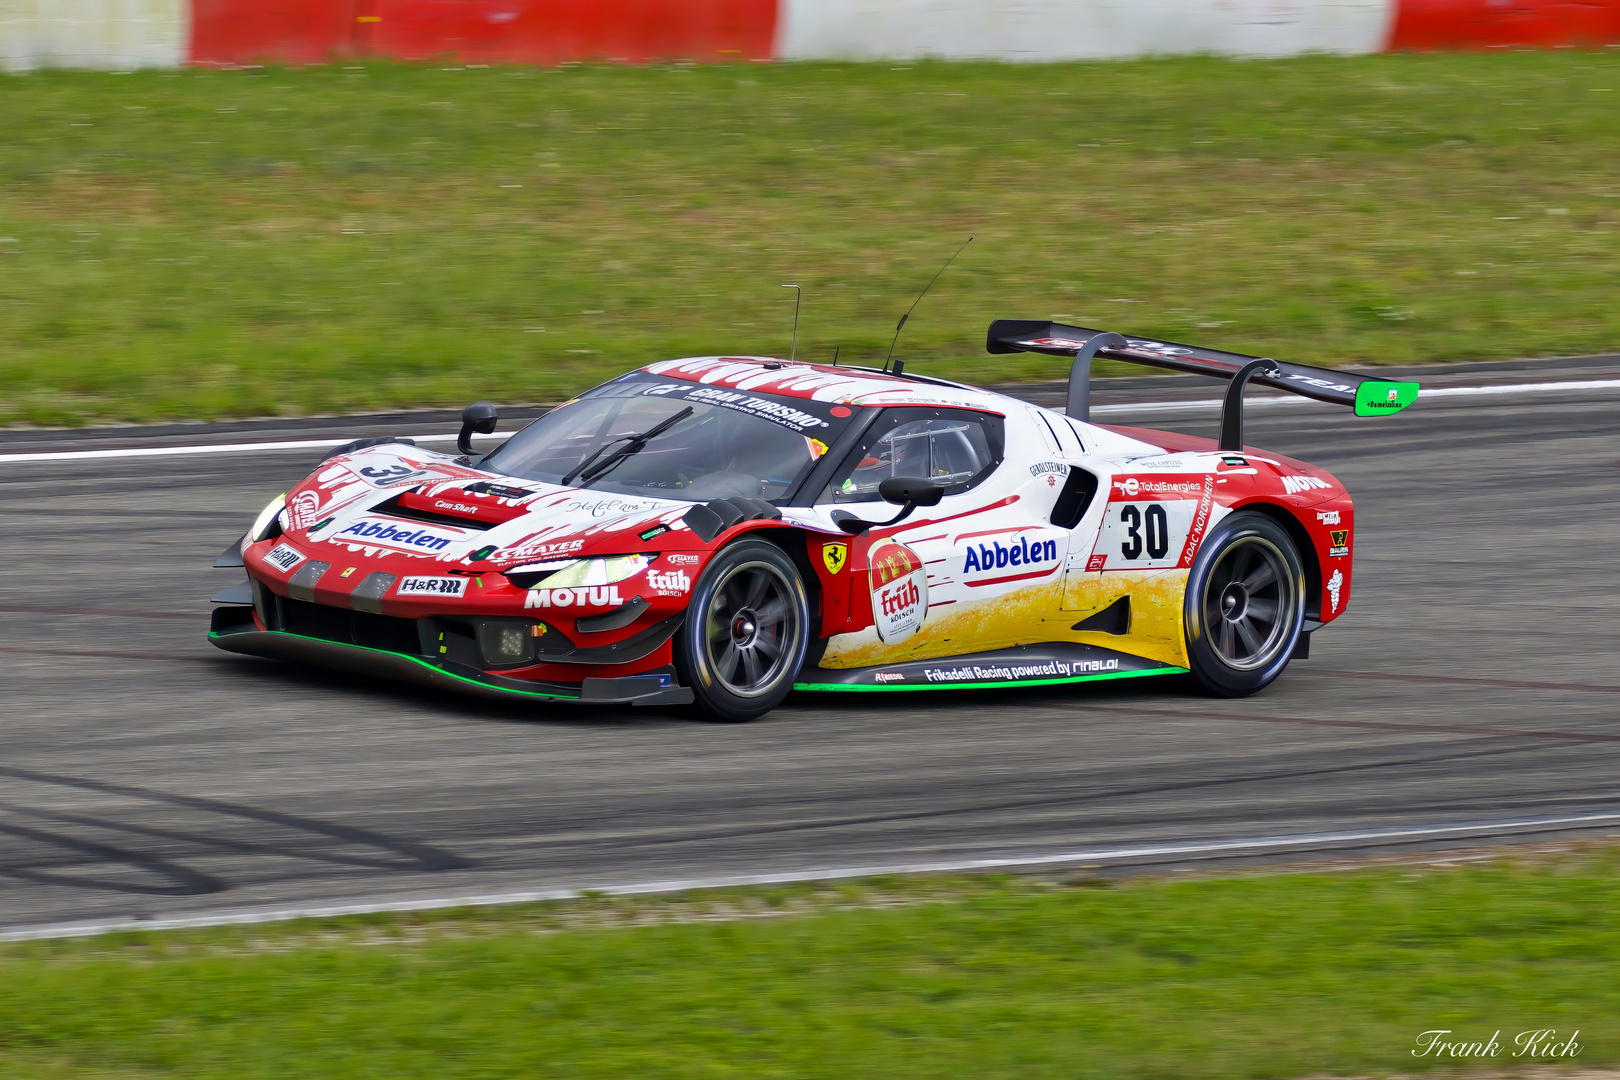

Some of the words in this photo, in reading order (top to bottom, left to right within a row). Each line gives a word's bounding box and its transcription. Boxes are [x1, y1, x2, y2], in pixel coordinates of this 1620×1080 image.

[689, 388, 747, 404] GRAN
[721, 402, 755, 414] DRIVING
[755, 411, 803, 431] SIMULATOR
[1029, 461, 1068, 477] GEROLSTEINER
[1140, 481, 1201, 493] TotalEnergies
[1280, 476, 1332, 494] MOTUL
[434, 500, 453, 509] Cam
[452, 504, 478, 514] Shaft
[565, 500, 623, 517] Hotel
[1183, 534, 1199, 565] ADAC
[1193, 475, 1214, 535] NORDRHEIN
[340, 521, 452, 550] Abbelen
[1120, 504, 1168, 559] 30
[515, 539, 585, 556] MAYER
[964, 537, 1056, 573] Abbelen
[524, 586, 624, 609] MOTUL
[924, 666, 974, 682] Frikadelli
[976, 665, 1012, 680] Racing
[1012, 662, 1054, 677] powered
[1055, 660, 1071, 676] by
